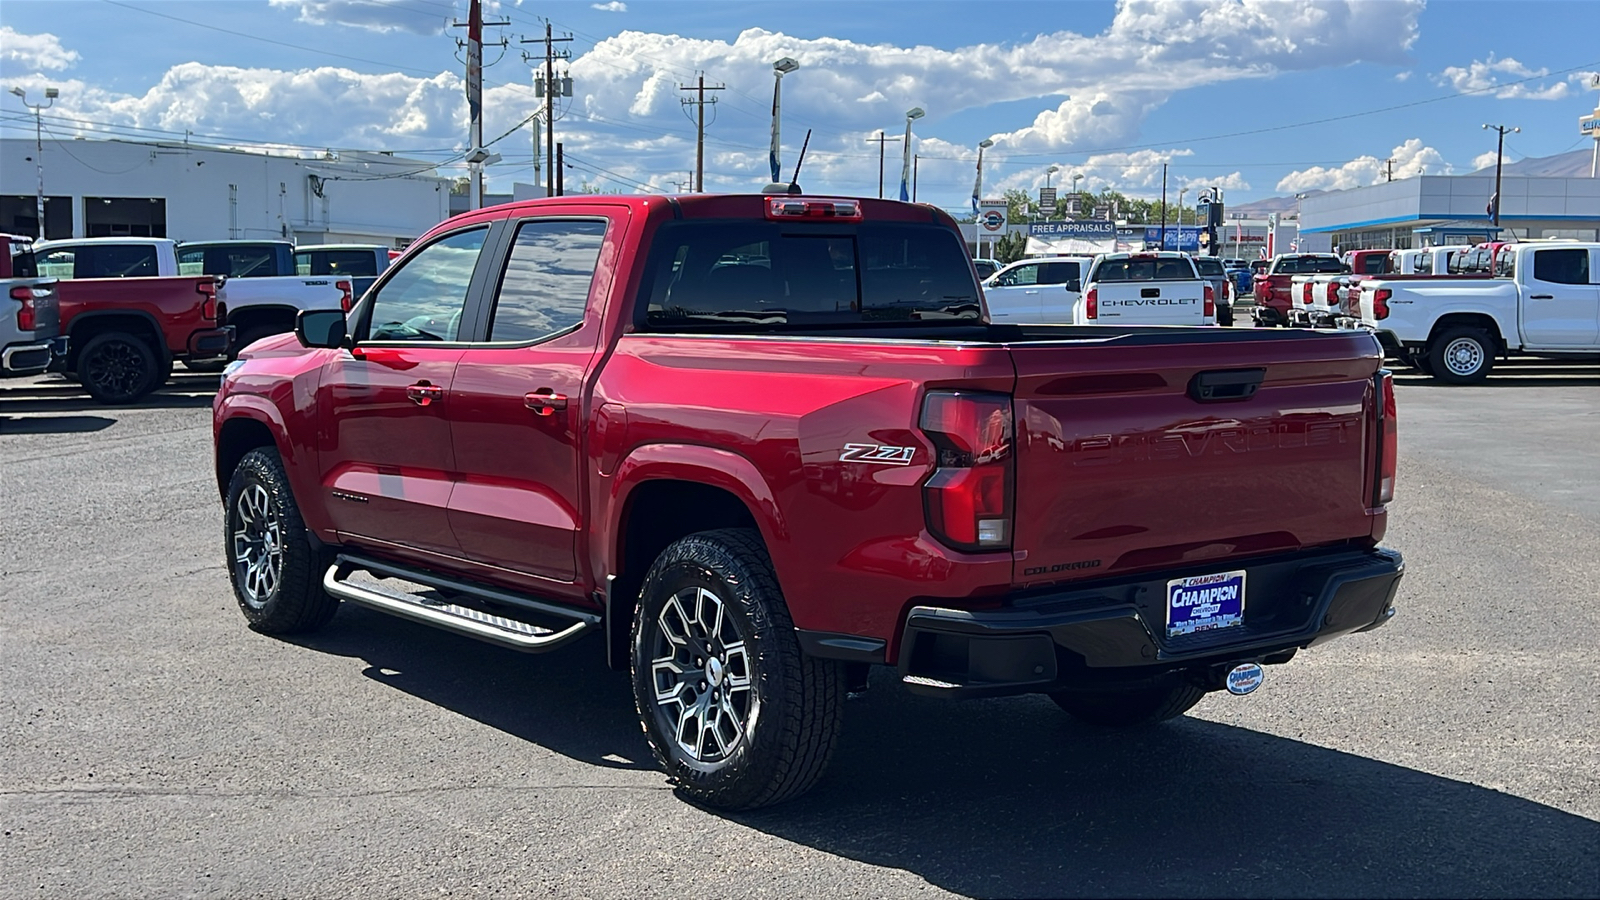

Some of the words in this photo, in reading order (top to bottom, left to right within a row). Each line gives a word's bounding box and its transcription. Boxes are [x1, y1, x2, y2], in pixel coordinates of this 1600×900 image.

[1032, 224, 1054, 233] FREE
[1056, 223, 1113, 233] APPRAISALS!
[1164, 233, 1178, 242] 0%
[1179, 233, 1198, 242] APR
[1101, 298, 1198, 307] CHEVROLET
[839, 442, 916, 466] Z71
[1023, 559, 1102, 576] COLORADO
[1188, 573, 1226, 586] CHAMPION
[1171, 584, 1238, 608] CHAMPION
[1192, 605, 1219, 615] CHEVROLET
[1194, 623, 1218, 632] RENO
